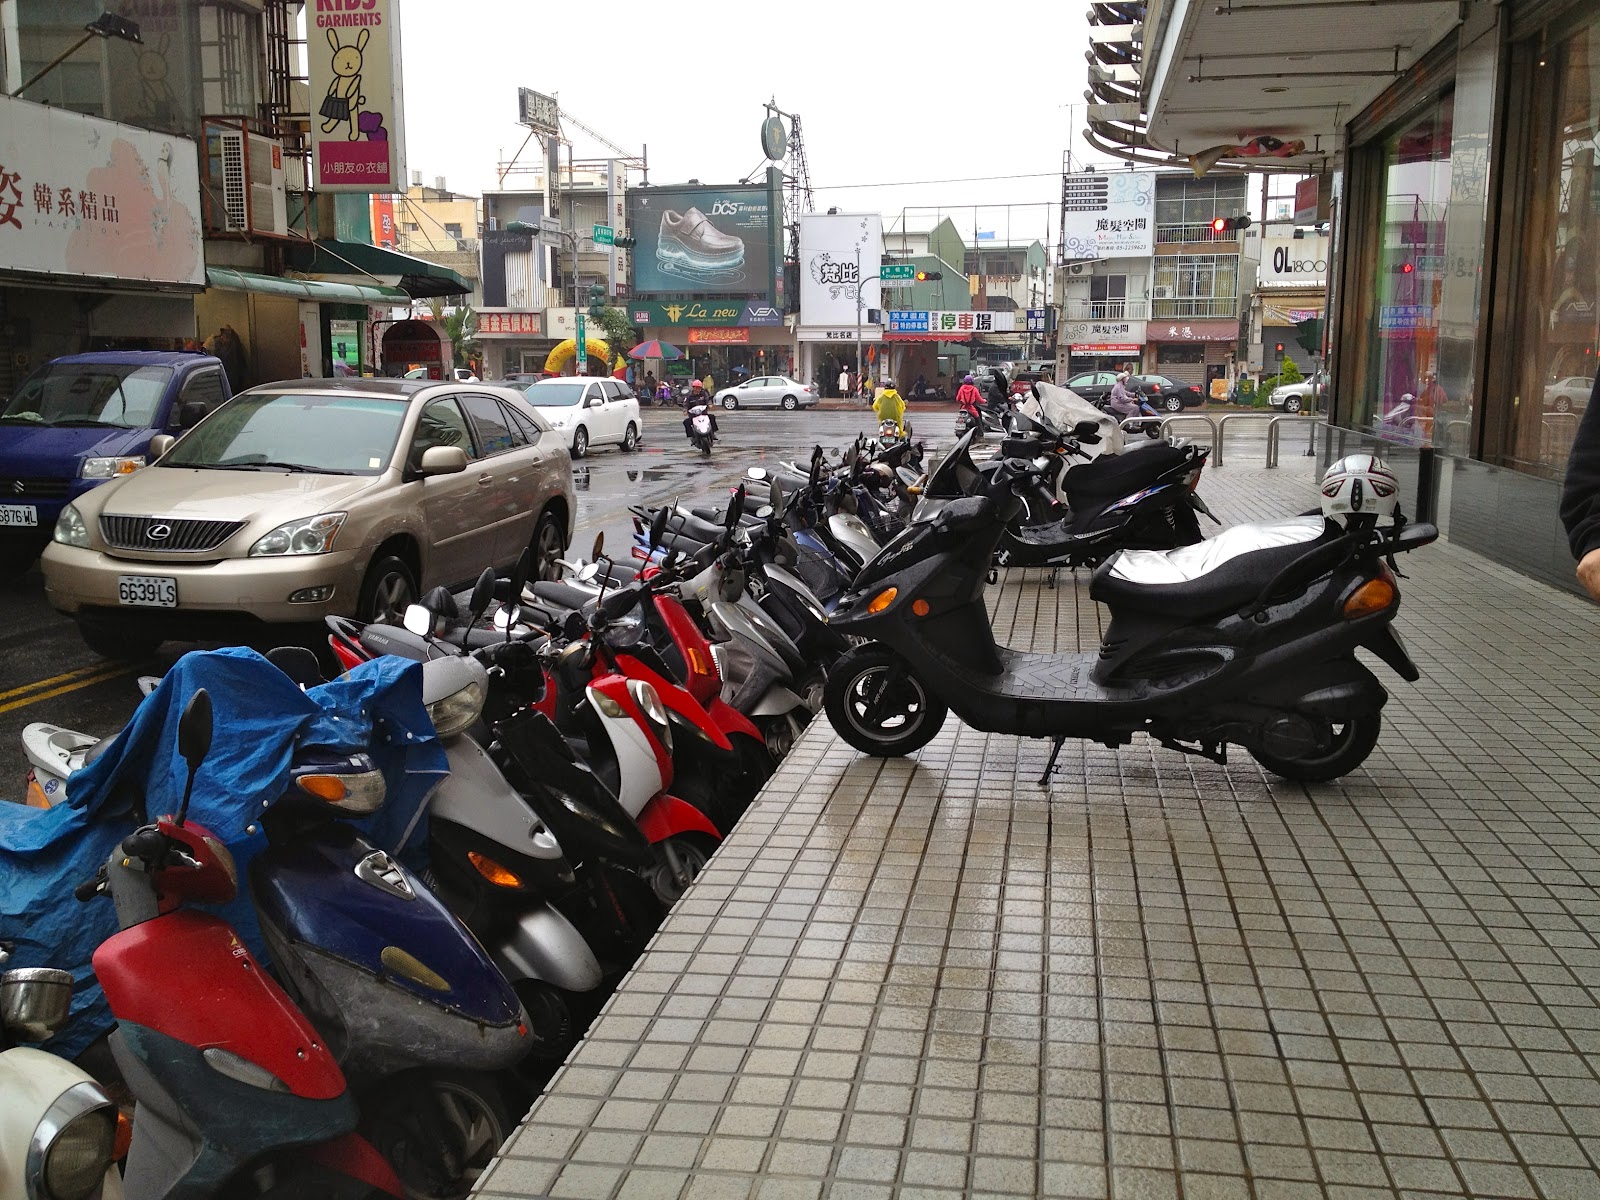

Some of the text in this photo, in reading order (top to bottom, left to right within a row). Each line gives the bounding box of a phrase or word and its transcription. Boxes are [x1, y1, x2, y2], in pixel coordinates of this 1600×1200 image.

[316, 12, 381, 28] GARMENTS
[33, 182, 119, 223] 韓系精品
[711, 202, 738, 216] DCS
[1094, 217, 1147, 232] 魔髮空間
[820, 262, 860, 284] 梵比
[686, 303, 739, 318] La new
[940, 313, 992, 331] 停車場
[1090, 324, 1129, 335] 魔髮空間
[119, 582, 175, 603] 6639-LS
[367, 634, 389, 645] YAMAHA
